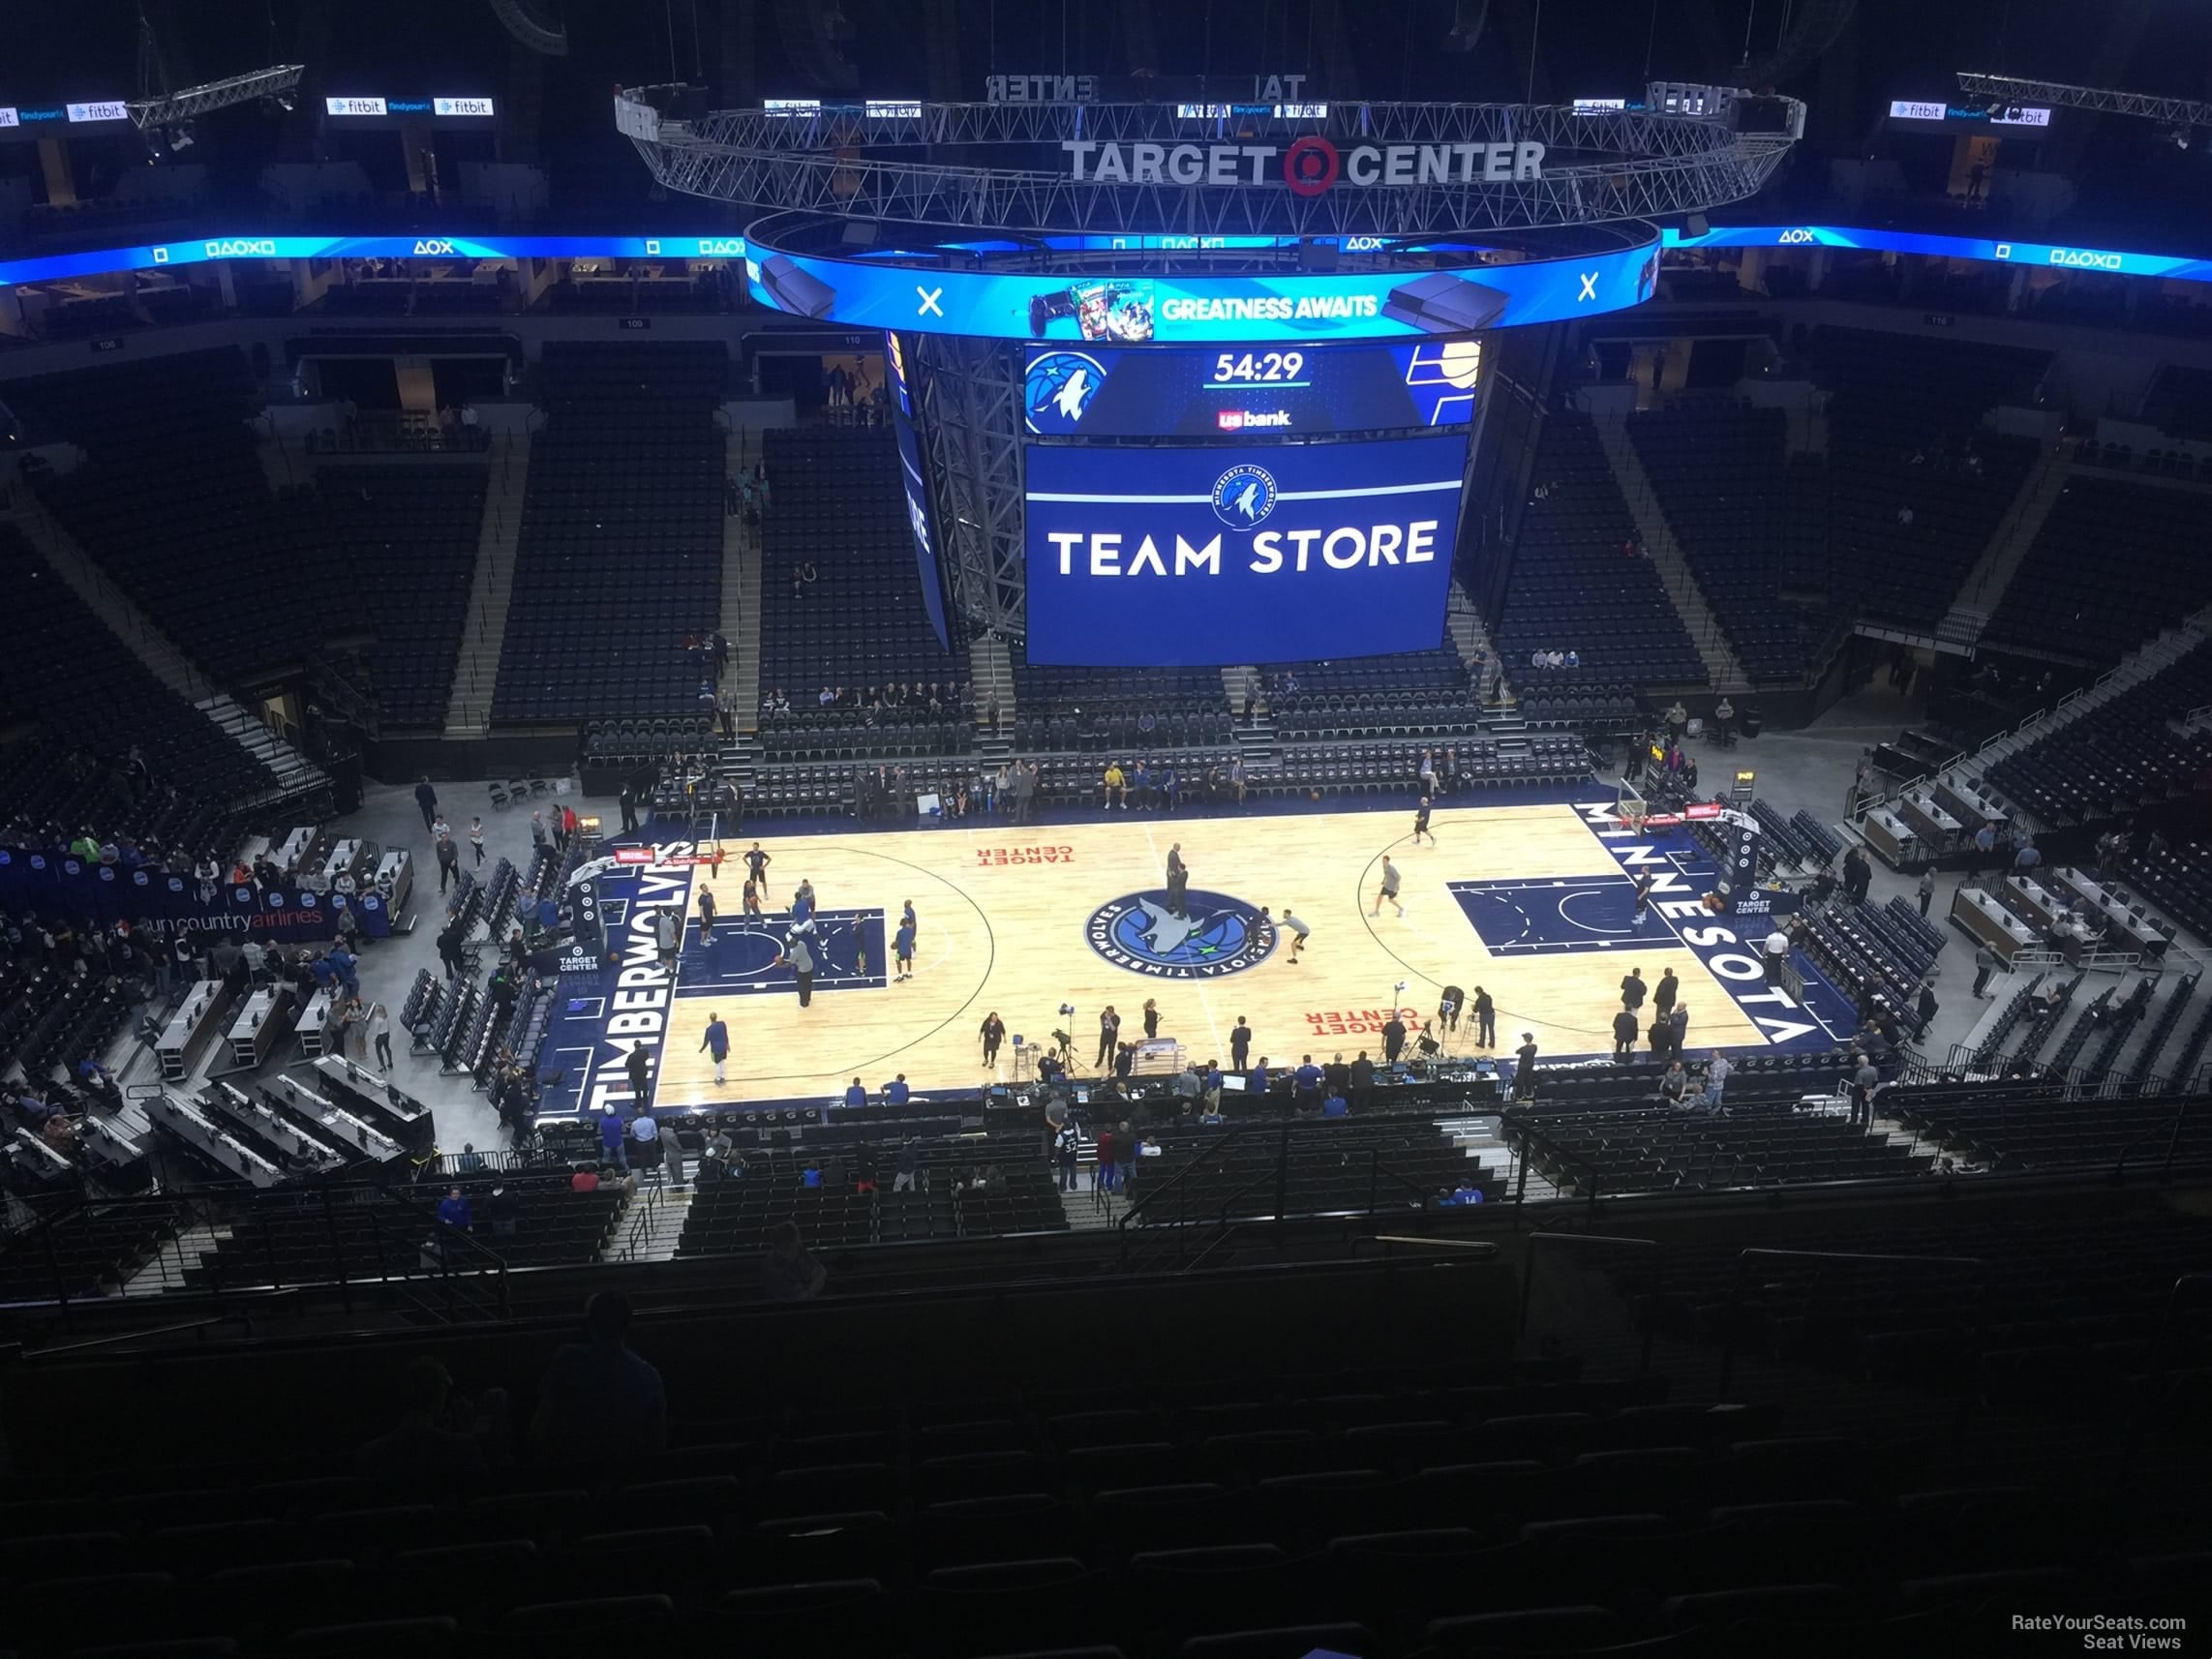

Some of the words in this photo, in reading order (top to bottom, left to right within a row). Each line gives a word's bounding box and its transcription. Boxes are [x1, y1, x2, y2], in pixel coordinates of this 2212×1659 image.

[88, 106, 120, 118] fitbit
[348, 100, 380, 113] fitbit
[455, 100, 486, 113] fitbit
[1910, 105, 1940, 117] fitbit
[1062, 141, 1277, 186] TARGET
[1347, 141, 1546, 186] CENTER
[1163, 298, 1294, 320] GREATNESS
[1294, 294, 1378, 319] AWAITS
[1214, 351, 1303, 382] 54:29
[1214, 468, 1245, 506] MINNESOTA
[1247, 467, 1275, 516] TIMBERWOLVES
[1048, 533, 1222, 576] TEAM
[1250, 520, 1439, 573] STORE
[1573, 802, 1818, 1043] MINNESOTA
[1092, 904, 1190, 977] TIMBERWOLVES
[559, 956, 597, 965] TARGET
[560, 963, 598, 972] CENTER
